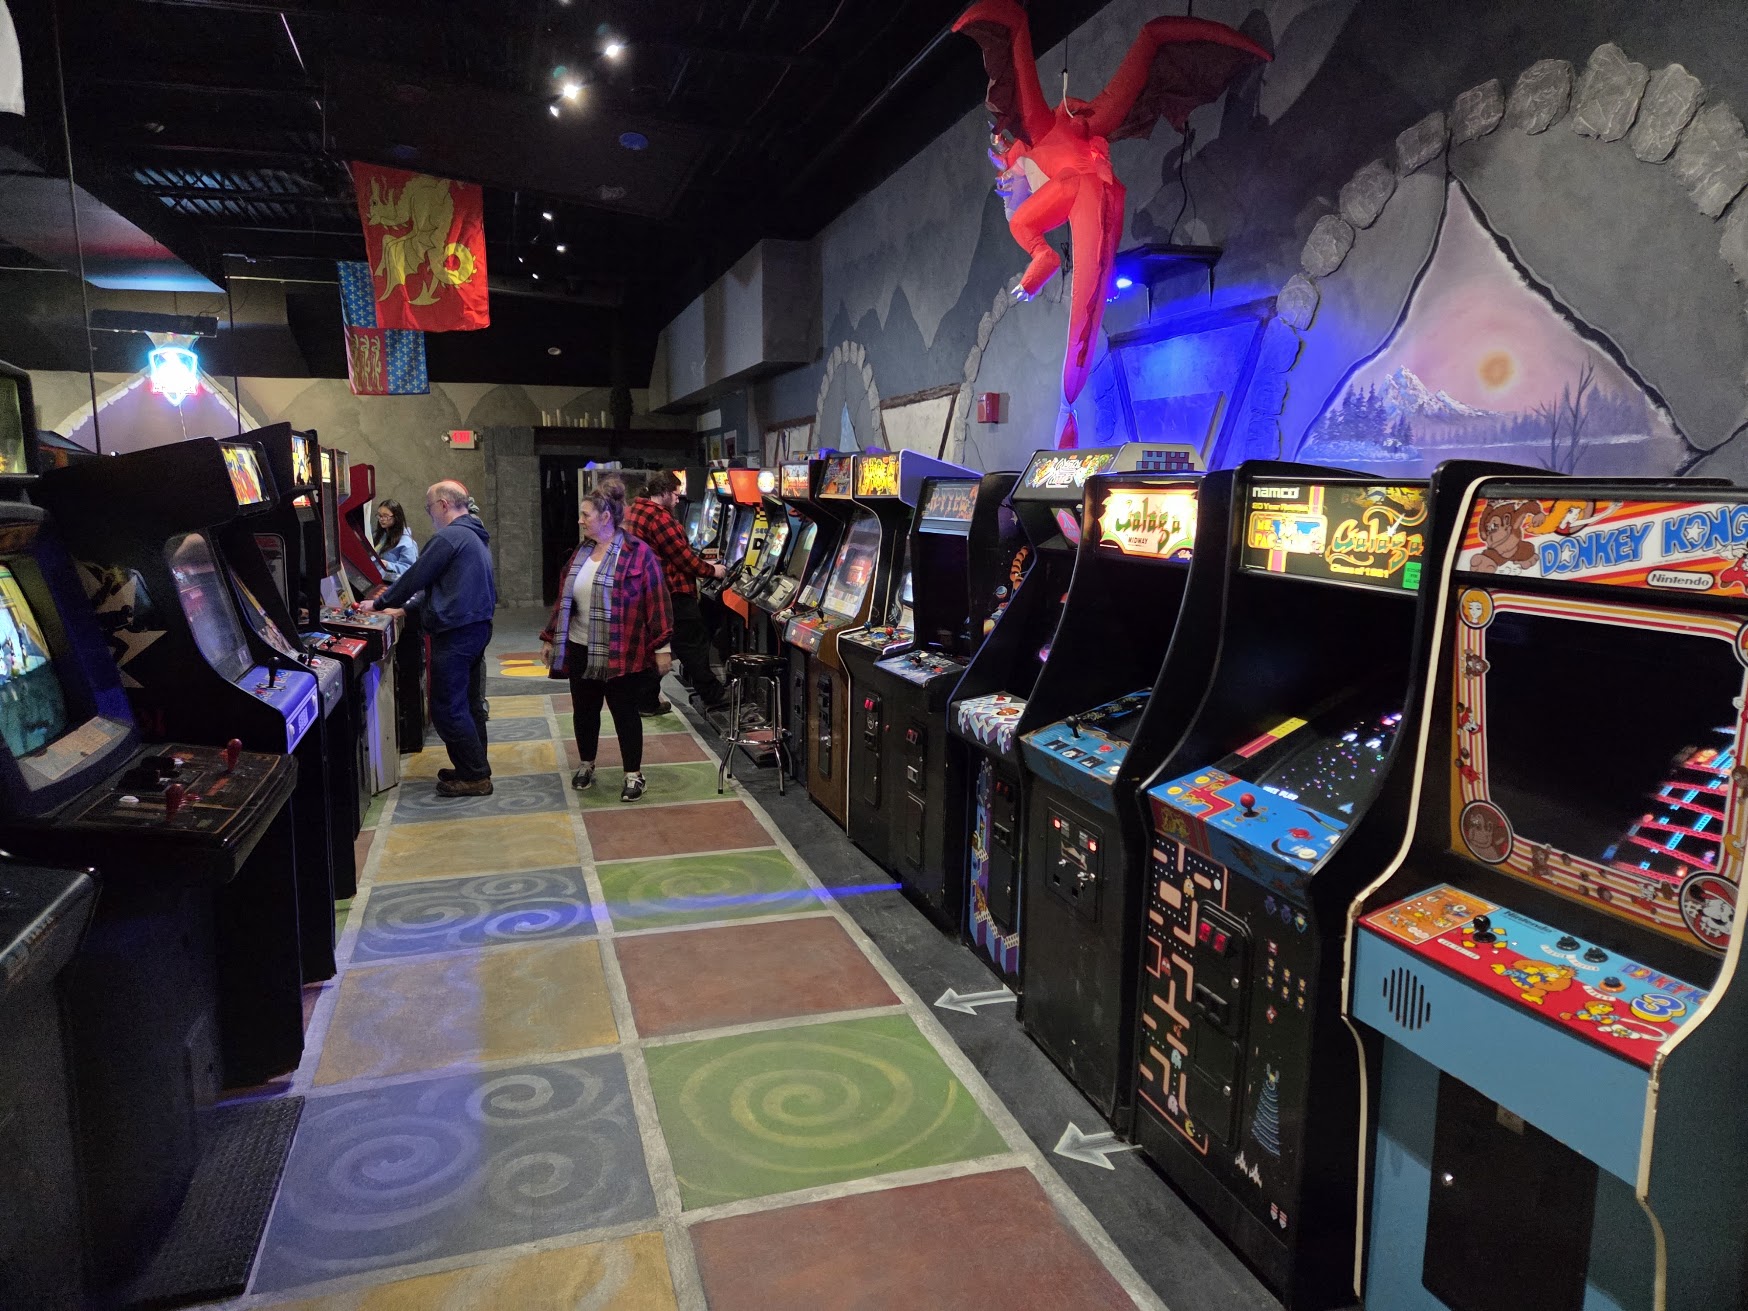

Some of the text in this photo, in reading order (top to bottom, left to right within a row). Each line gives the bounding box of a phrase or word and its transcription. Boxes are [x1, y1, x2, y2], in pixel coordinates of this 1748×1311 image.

[1253, 487, 1300, 499] namco
[1331, 518, 1424, 574] Galaga
[1538, 503, 1748, 577] DONKEY KONG
[1650, 573, 1710, 588] Nintendo
[1503, 911, 1553, 933] Nintendo
[1620, 963, 1694, 996] DONKEY
[1630, 993, 1687, 1023] 3
